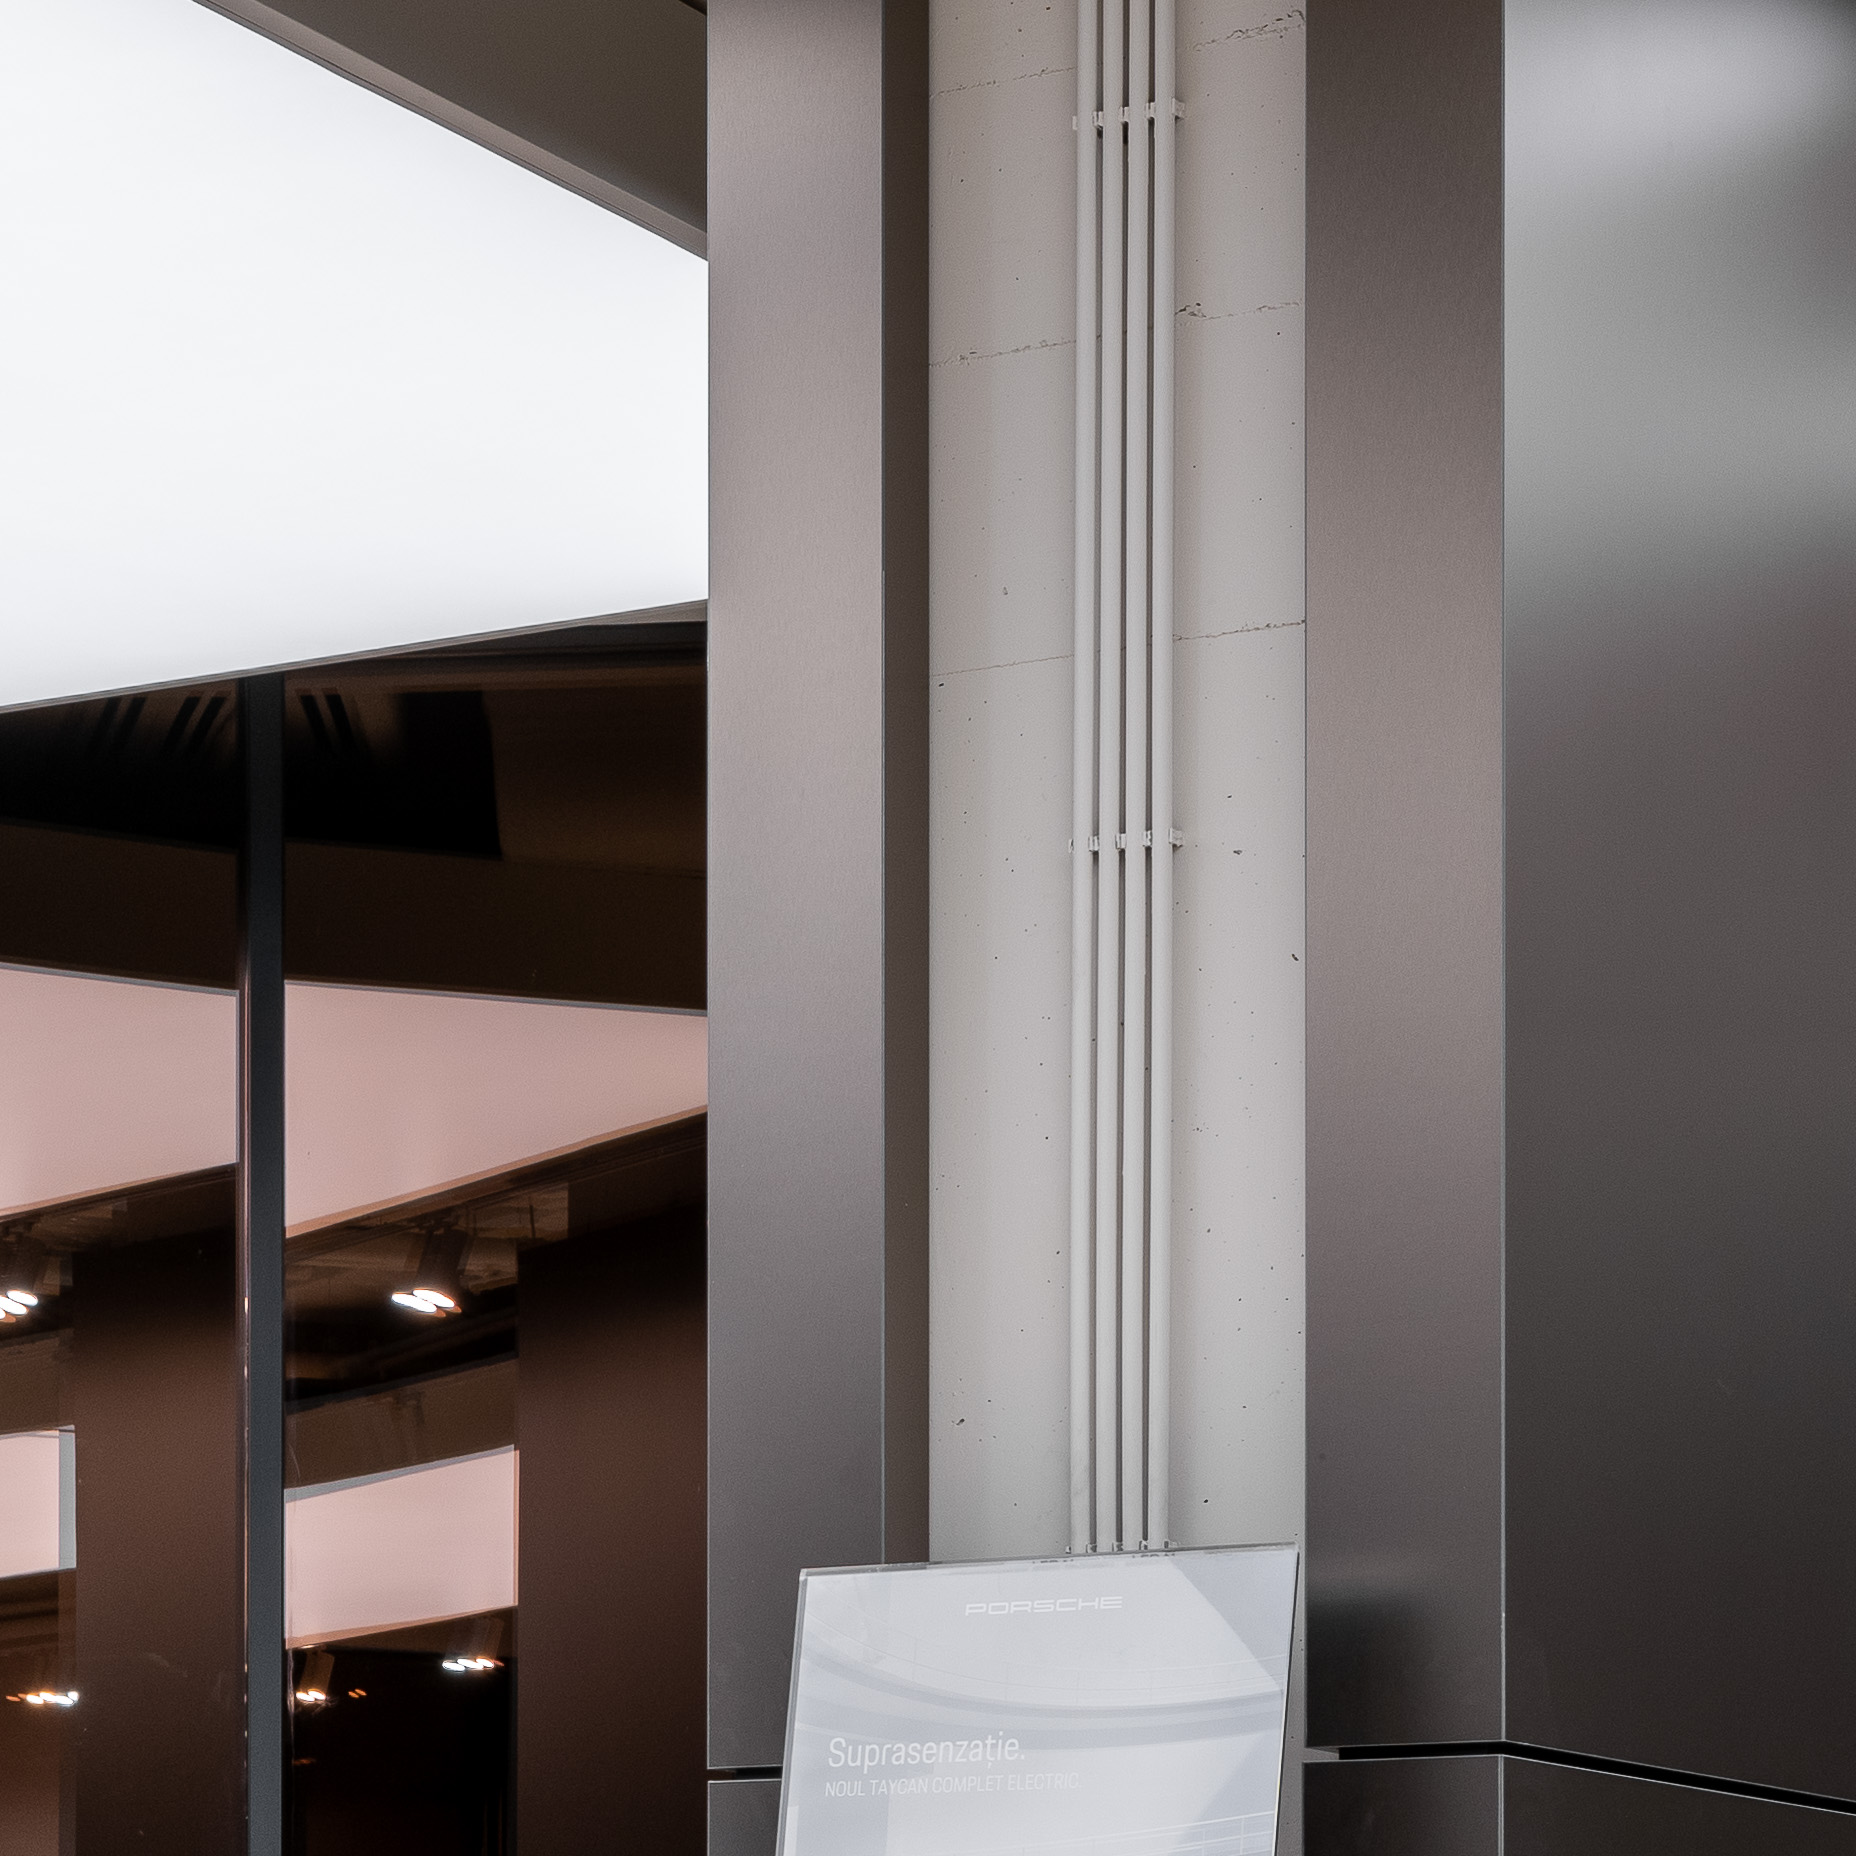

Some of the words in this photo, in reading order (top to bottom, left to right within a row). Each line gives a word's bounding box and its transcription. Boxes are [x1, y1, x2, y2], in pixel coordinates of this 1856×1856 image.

[965, 1596, 1123, 1616] PORSCHE
[825, 1780, 866, 1797] NOUL
[869, 1777, 928, 1796] TAYCAN
[932, 1775, 1004, 1794] COMPLET
